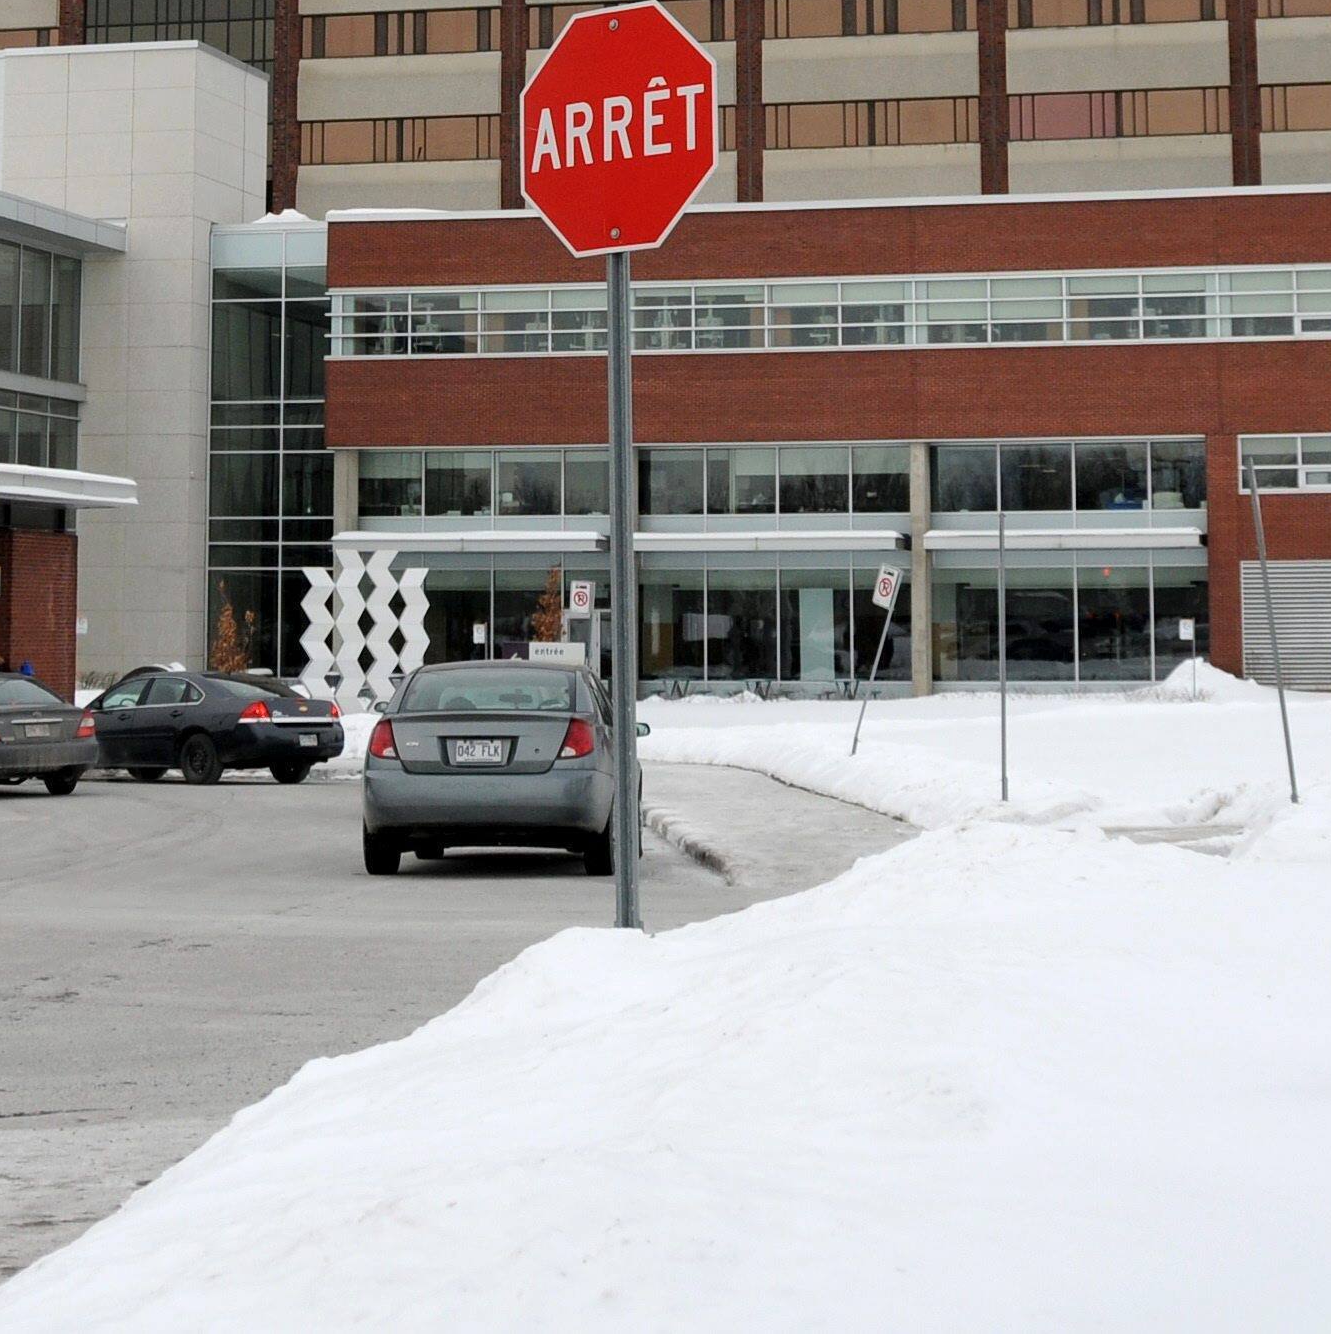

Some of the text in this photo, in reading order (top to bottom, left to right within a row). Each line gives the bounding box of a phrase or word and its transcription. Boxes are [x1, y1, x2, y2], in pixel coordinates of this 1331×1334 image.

[531, 76, 705, 173] ARRÊT
[534, 647, 564, 656] entrée
[457, 745, 500, 757] 042 FLK
